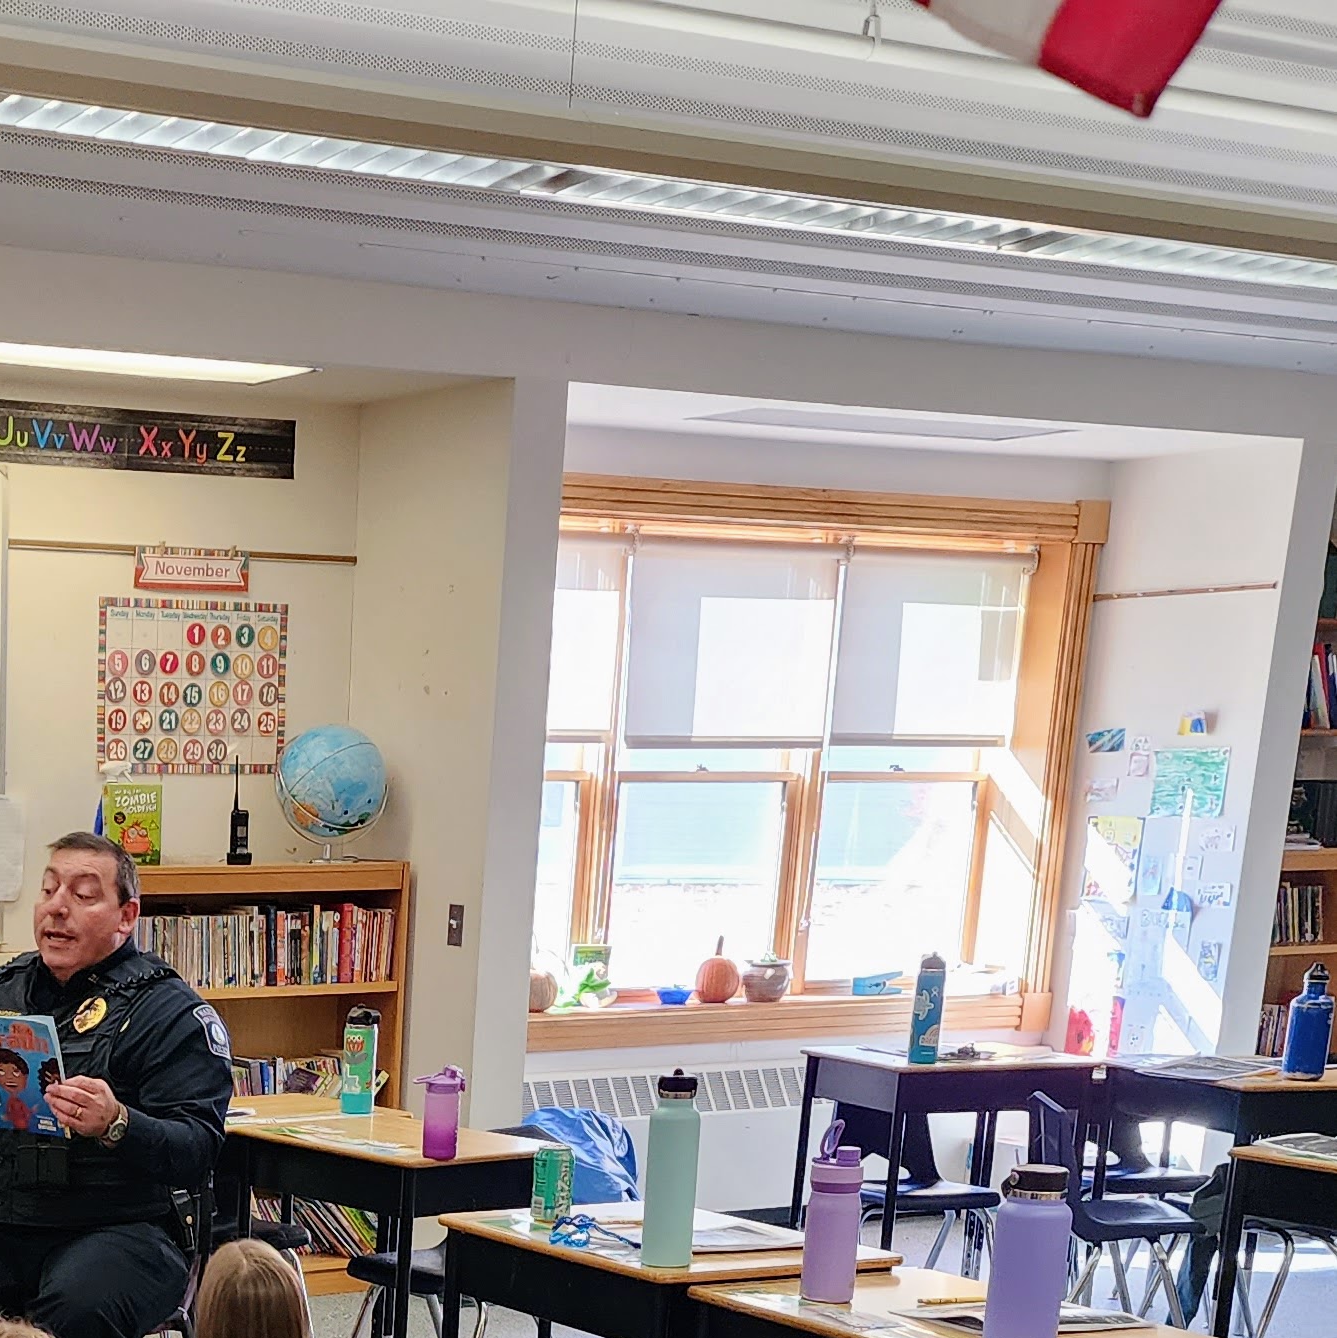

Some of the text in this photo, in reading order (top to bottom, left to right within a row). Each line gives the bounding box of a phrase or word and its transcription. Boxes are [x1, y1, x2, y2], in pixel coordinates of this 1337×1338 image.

[32, 418, 66, 451] Vv
[68, 421, 117, 455] Ww
[138, 425, 174, 458] Xx
[177, 428, 208, 464] Yy
[216, 432, 248, 463] Zz
[155, 560, 230, 579] November
[192, 625, 272, 646] 1 2 3 4
[114, 654, 273, 676] 5 6 7 8 9 10 11
[109, 681, 274, 703] 12 13 14 15 16 17 18
[111, 712, 124, 728] 19
[162, 712, 176, 729] 21
[184, 712, 199, 729] 22
[209, 713, 223, 730] 23
[234, 712, 248, 729] 24
[260, 715, 274, 732] 25
[110, 742, 224, 760] 26 27 28 29 30
[115, 791, 157, 808] ZOMBIE
